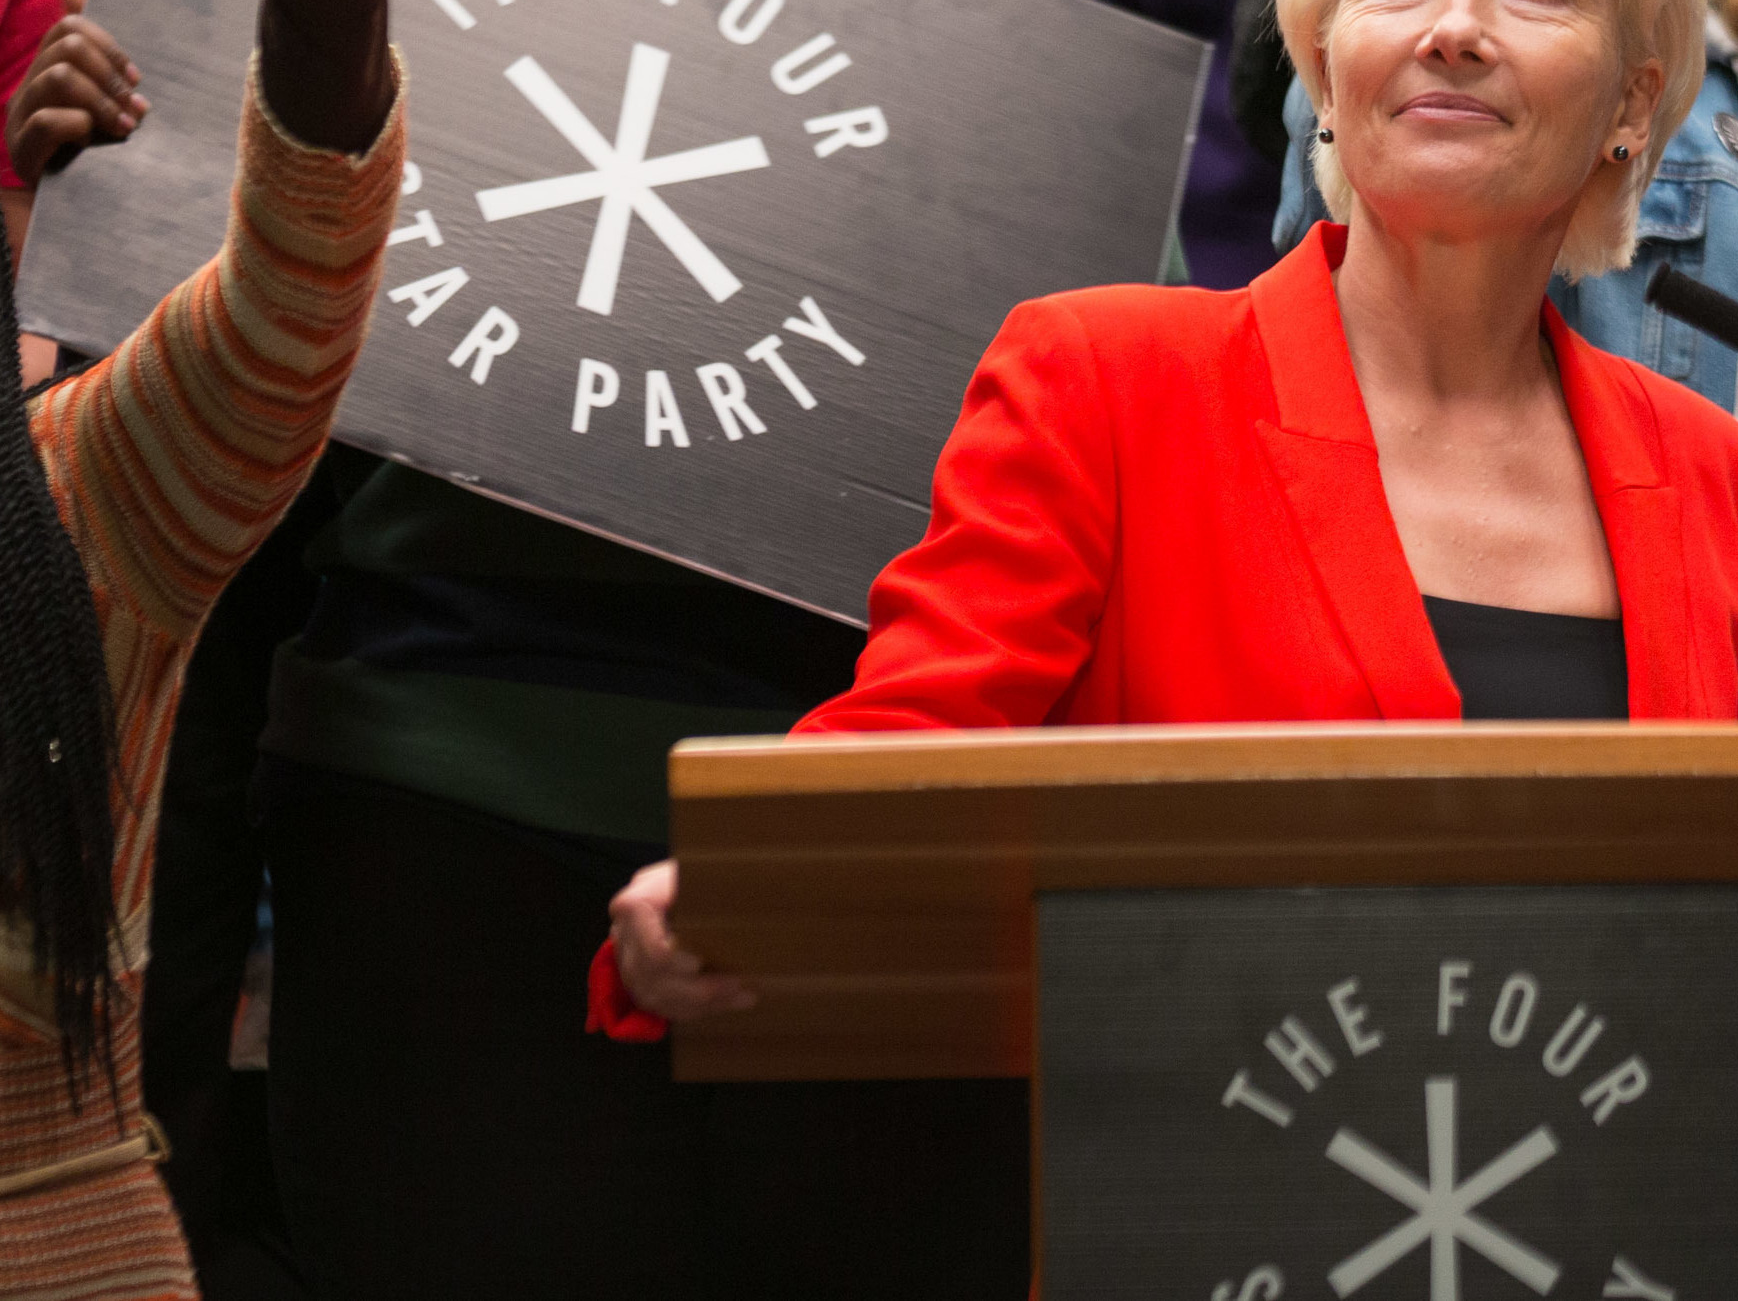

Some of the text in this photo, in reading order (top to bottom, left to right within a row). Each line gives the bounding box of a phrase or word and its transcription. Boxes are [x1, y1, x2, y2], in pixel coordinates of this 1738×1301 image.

[571, 295, 868, 449] PARTY
[1220, 958, 1652, 1129] THE FOUR
